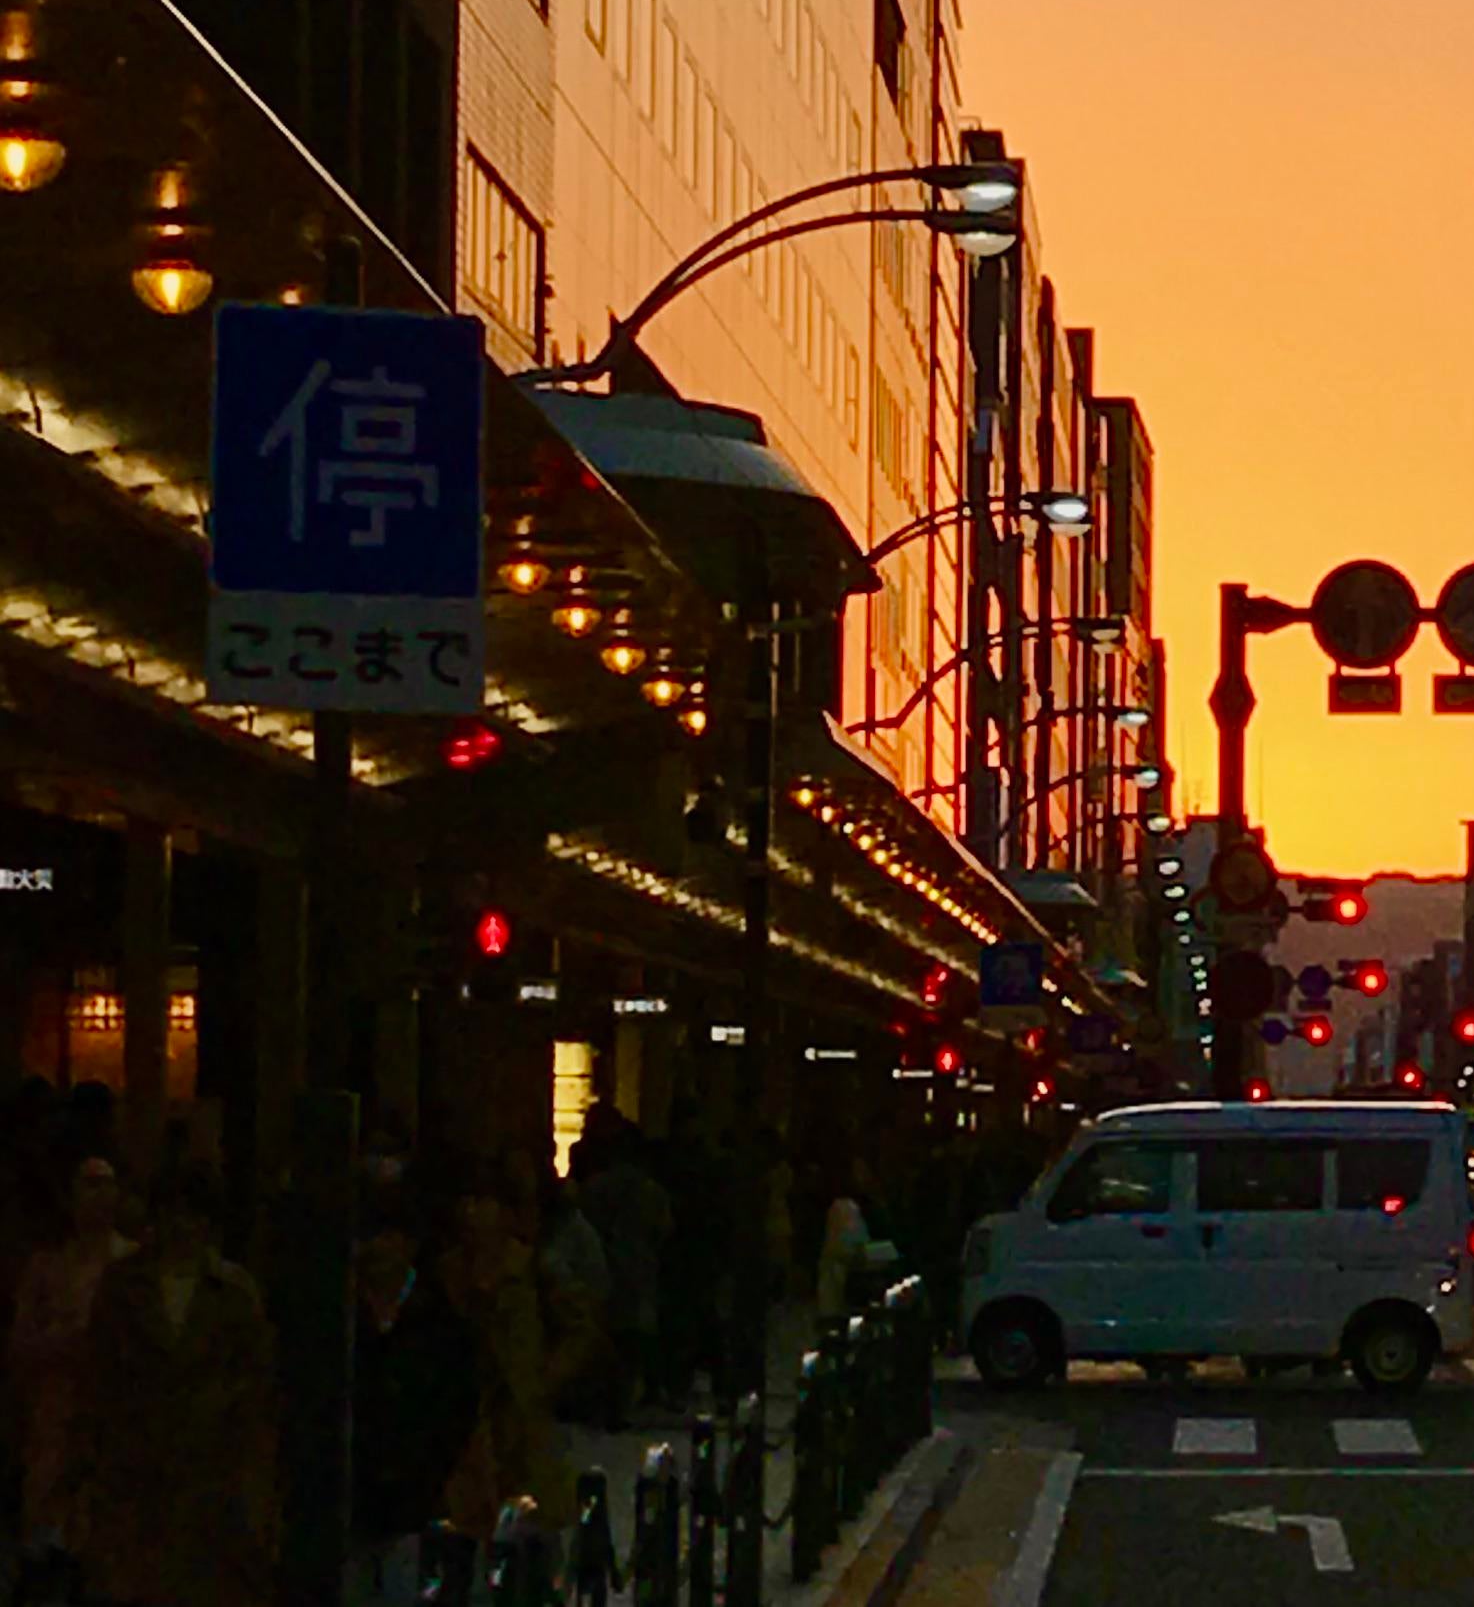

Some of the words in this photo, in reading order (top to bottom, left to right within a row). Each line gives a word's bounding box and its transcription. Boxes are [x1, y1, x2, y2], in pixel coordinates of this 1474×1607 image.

[258, 357, 441, 548] 停
[221, 622, 471, 688] ここまで
